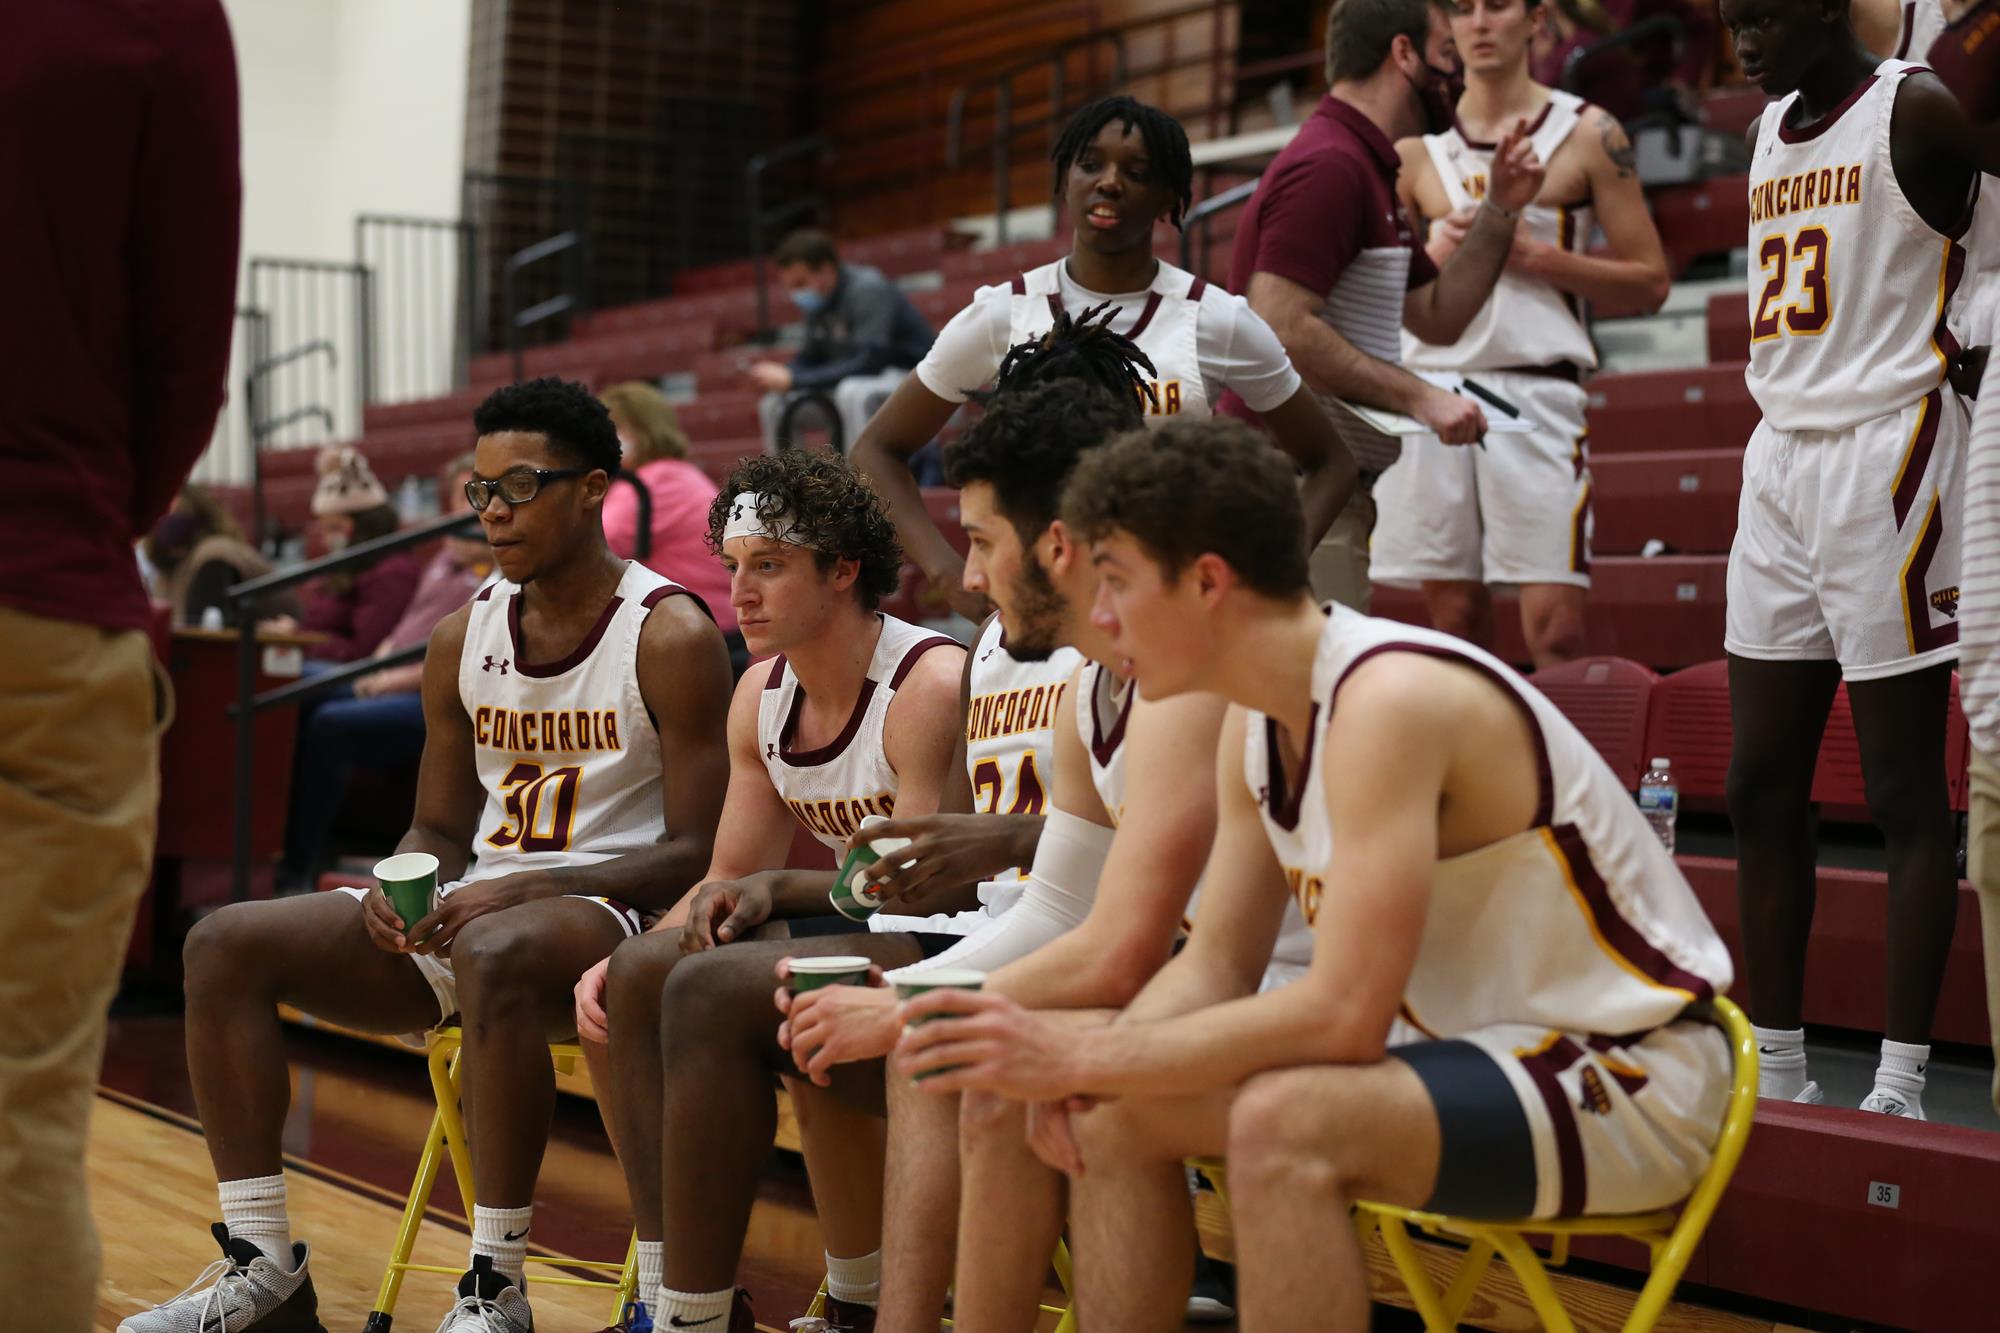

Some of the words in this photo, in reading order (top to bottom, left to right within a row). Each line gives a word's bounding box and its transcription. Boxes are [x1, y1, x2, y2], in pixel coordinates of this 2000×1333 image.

[1750, 162, 1862, 225] CONCORDIA
[1752, 224, 1833, 344] 23
[475, 704, 624, 752] CONCORDIA
[966, 680, 1069, 744] ONCORDI
[485, 758, 584, 853] 30
[1876, 1185, 1892, 1203] 35
